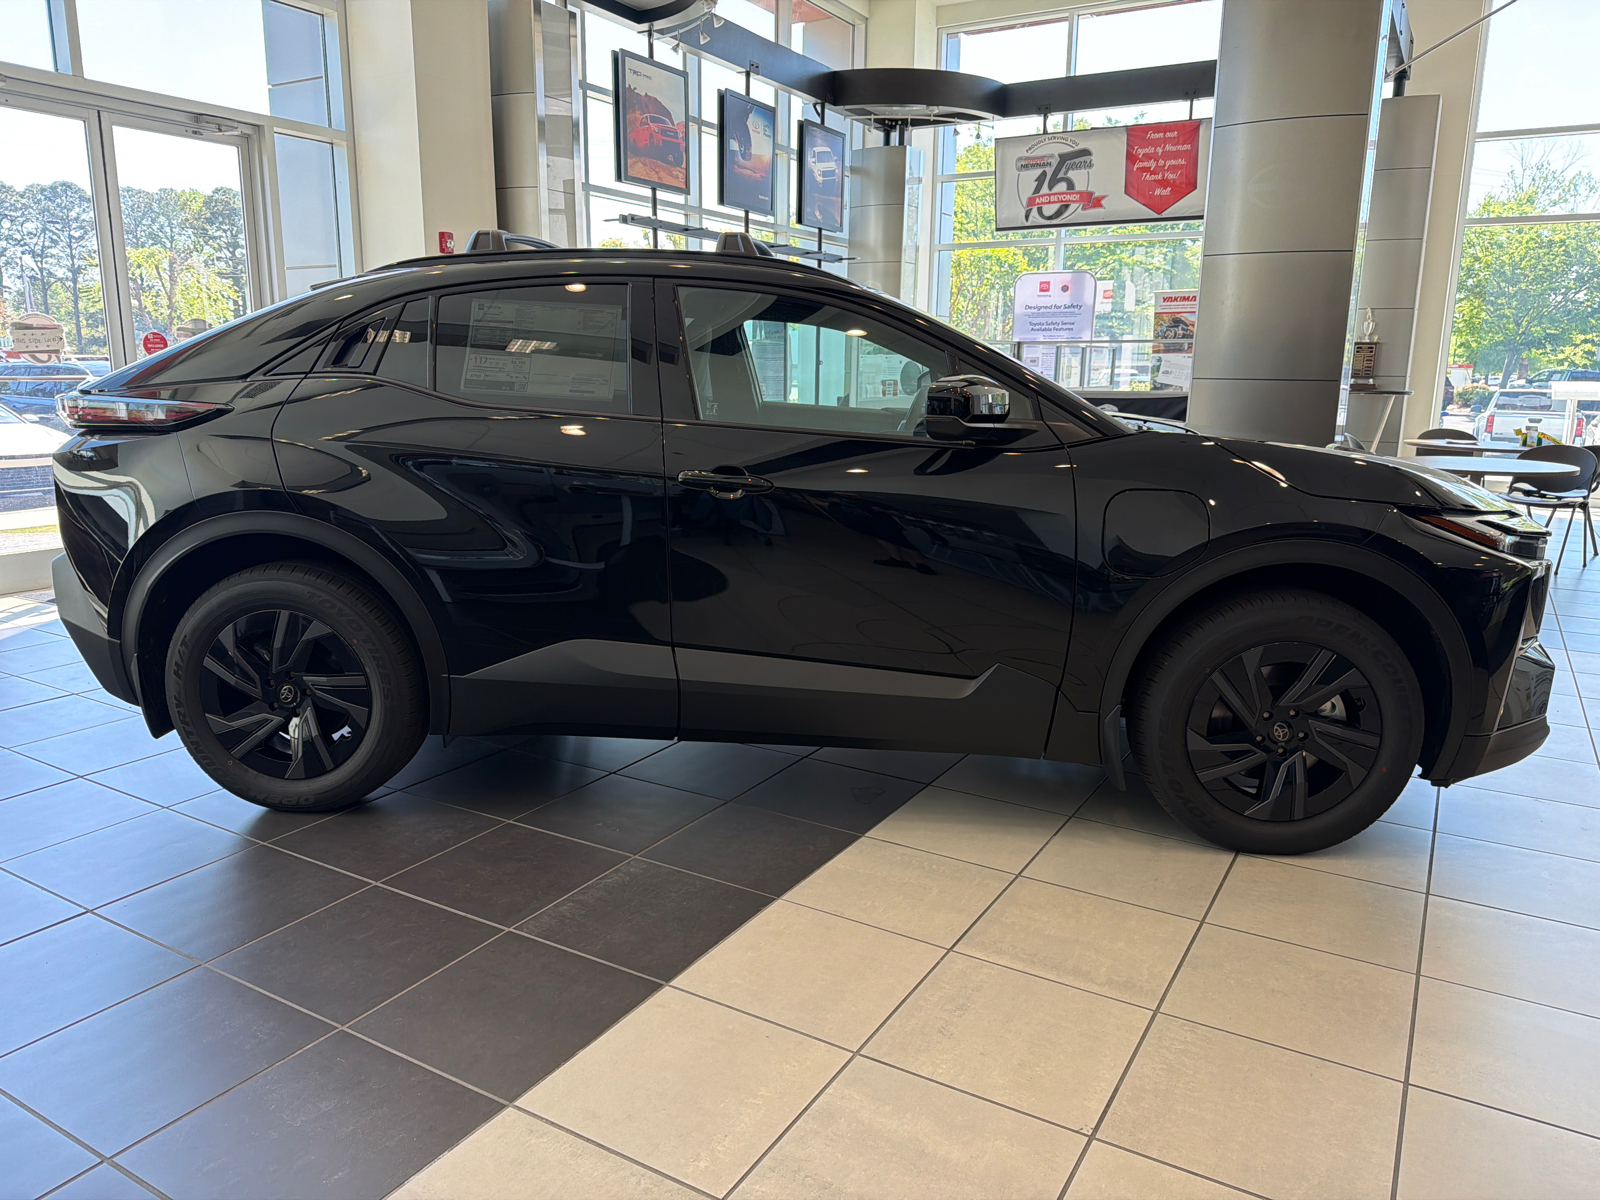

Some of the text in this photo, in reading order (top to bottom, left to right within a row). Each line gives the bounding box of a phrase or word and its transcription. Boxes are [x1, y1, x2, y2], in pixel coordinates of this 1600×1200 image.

[1146, 131, 1164, 140] From
[1026, 137, 1047, 154] PROUDLY
[1069, 138, 1080, 147] YOU
[1133, 145, 1155, 158] Toyota
[1156, 144, 1164, 156] of
[1020, 161, 1052, 169] NEWNAN
[1134, 158, 1187, 172] family to yours.
[1142, 170, 1181, 181] Thank You!
[1024, 149, 1094, 222] 15 years
[1036, 194, 1080, 204] AND BEYOND!
[1162, 295, 1197, 303] YAKIMA
[473, 356, 488, 365] 117
[306, 590, 364, 633] TOYO
